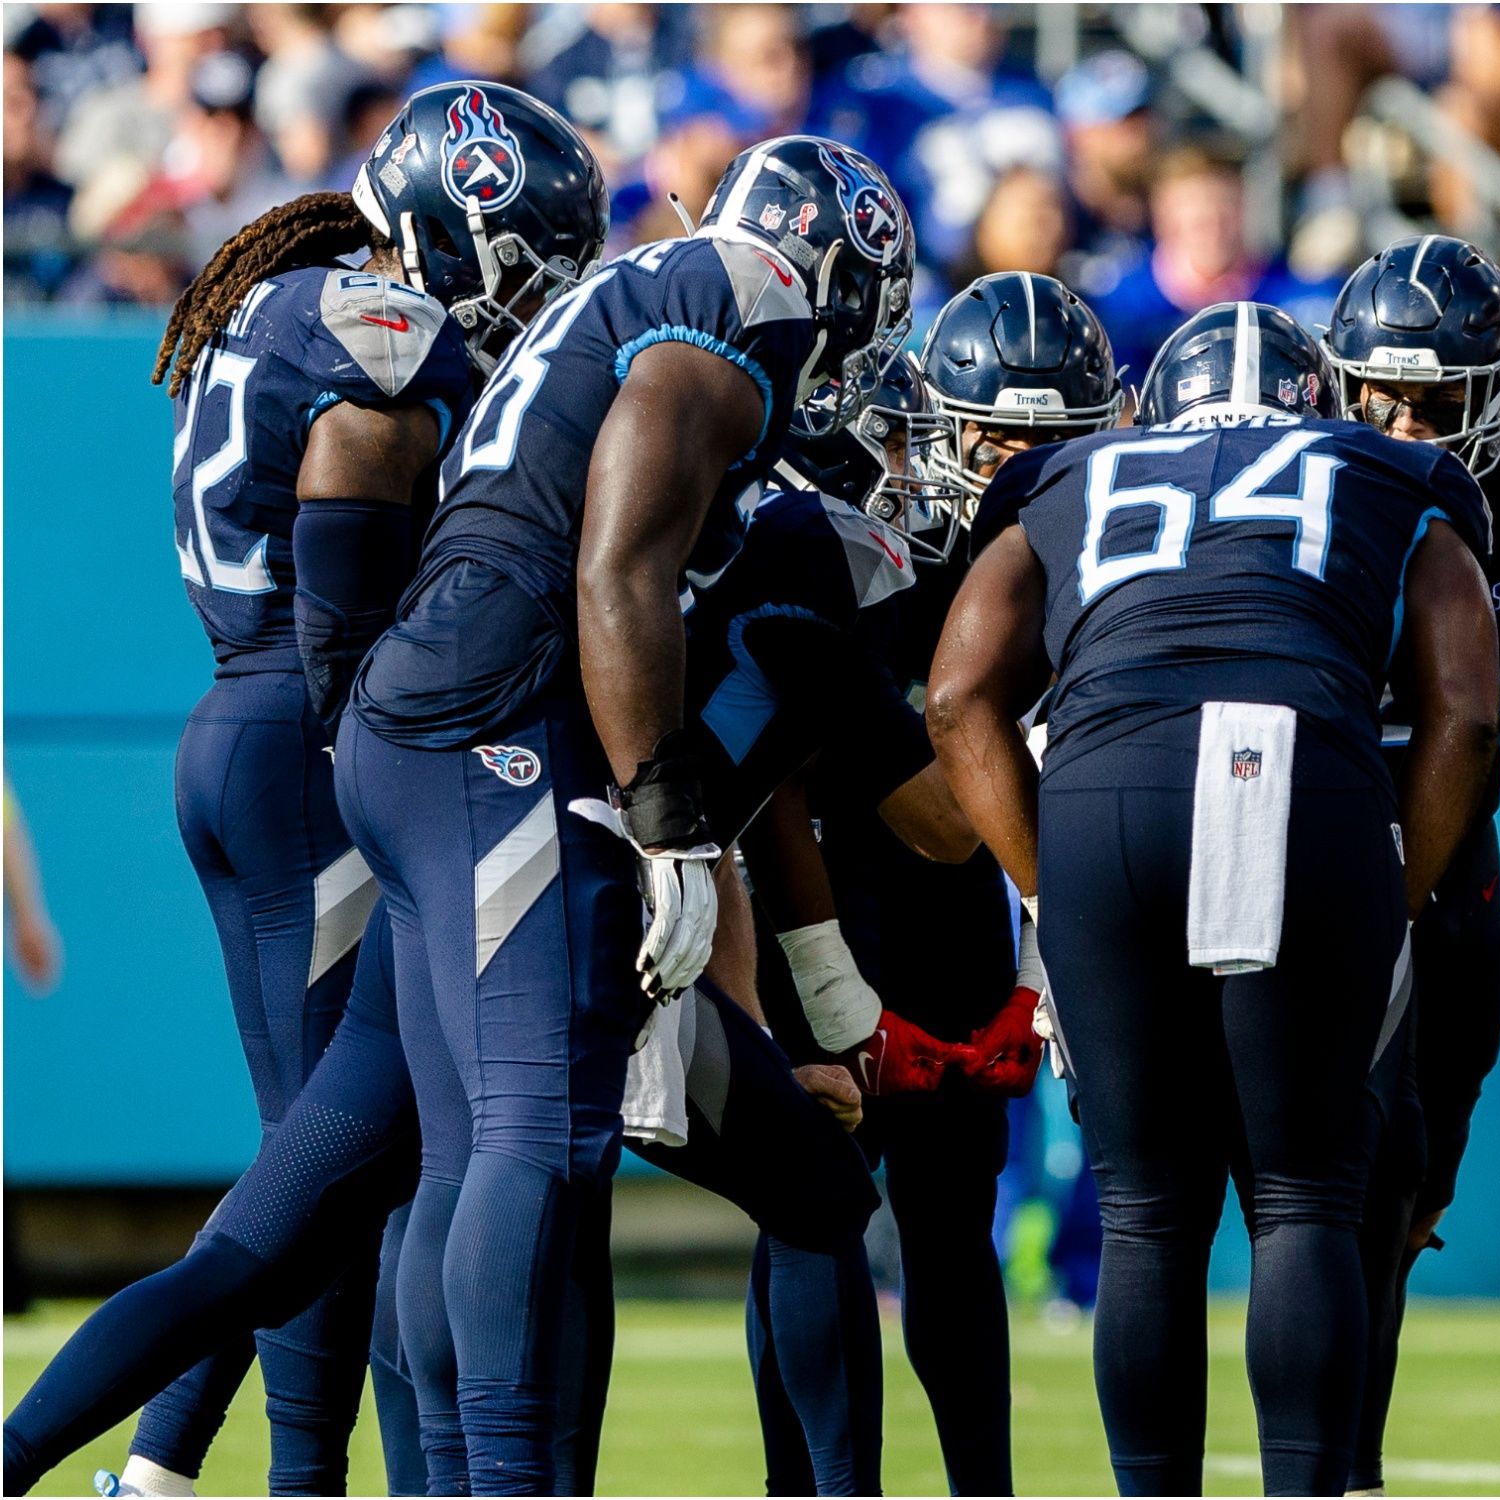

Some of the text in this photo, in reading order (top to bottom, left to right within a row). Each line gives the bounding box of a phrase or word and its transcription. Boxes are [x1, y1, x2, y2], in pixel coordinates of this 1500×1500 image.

[1386, 351, 1420, 366] TITANS
[1014, 393, 1048, 406] TITANS
[1078, 430, 1346, 606] 64
[1234, 761, 1258, 777] NFL
